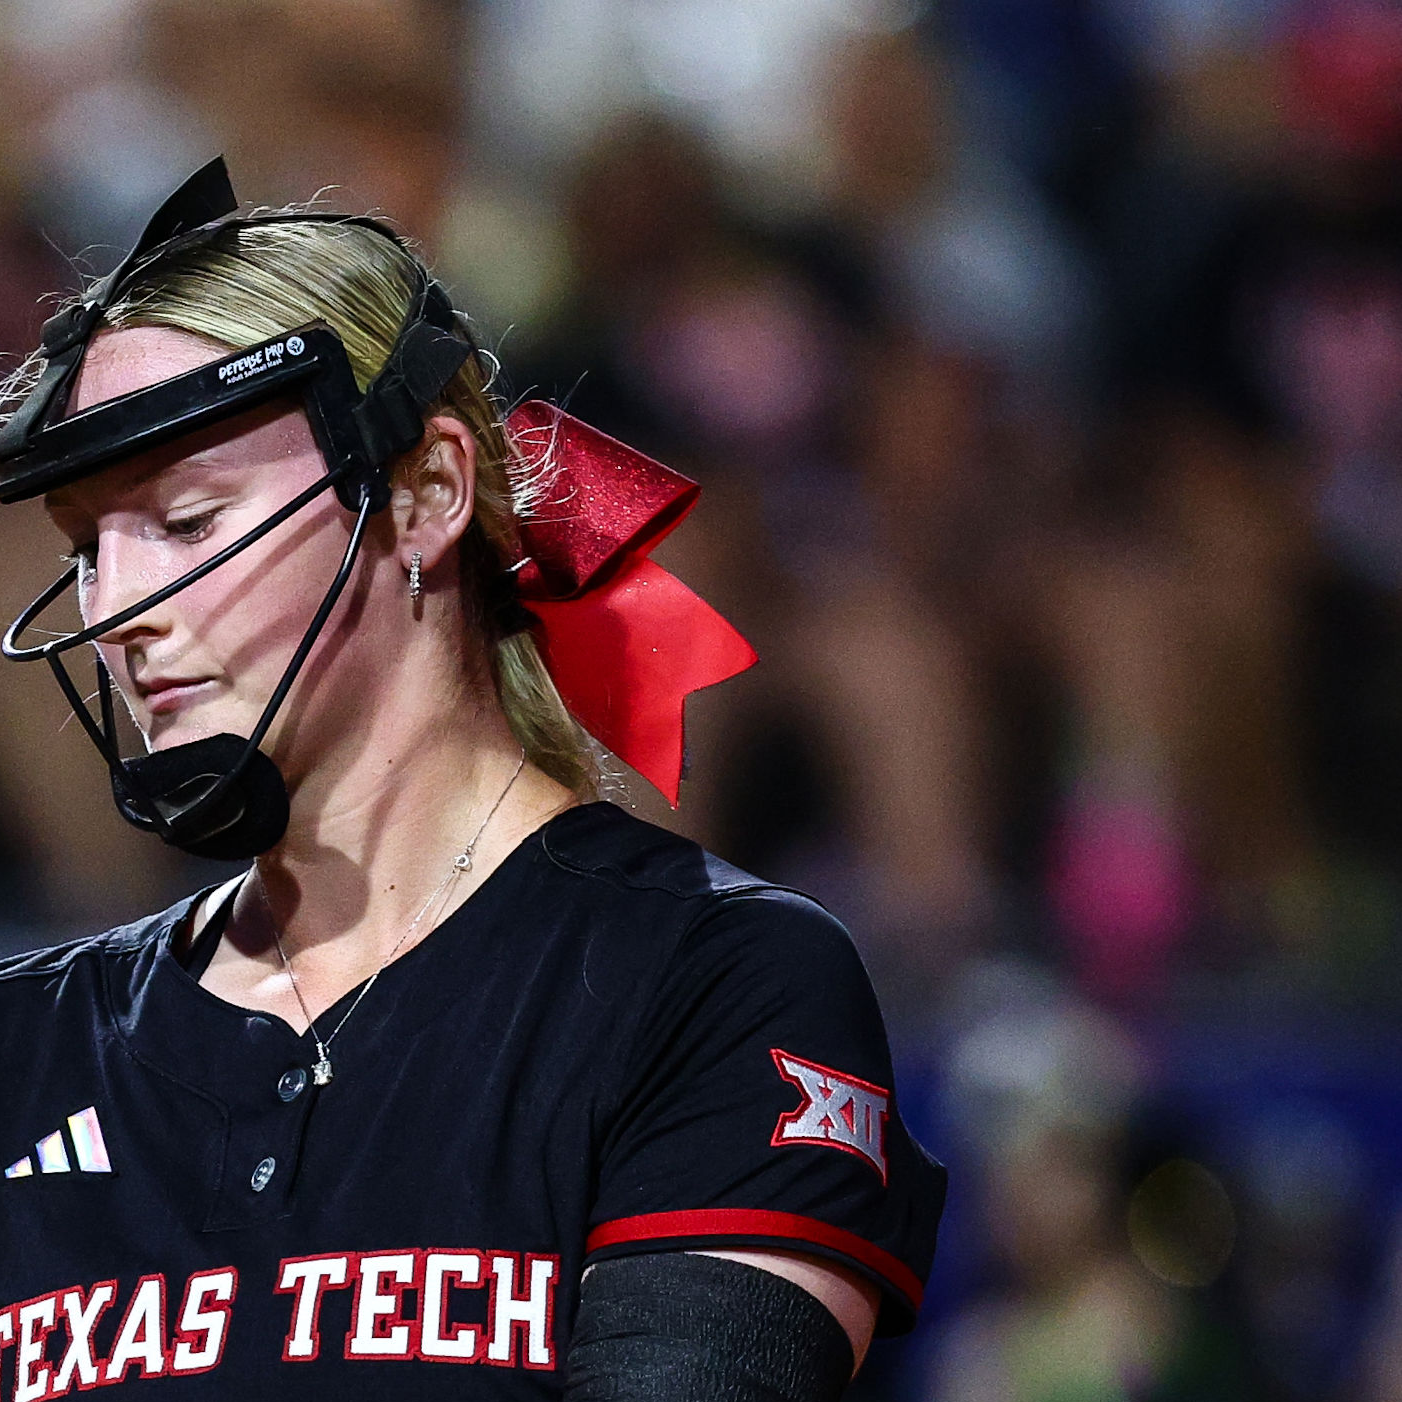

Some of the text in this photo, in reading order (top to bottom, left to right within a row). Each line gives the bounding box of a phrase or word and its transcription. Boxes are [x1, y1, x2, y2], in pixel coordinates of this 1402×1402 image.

[218, 342, 284, 380] DEFENSE PRO
[243, 364, 267, 378] Softball
[267, 358, 283, 369] Mask
[273, 1247, 560, 1371] TECH
